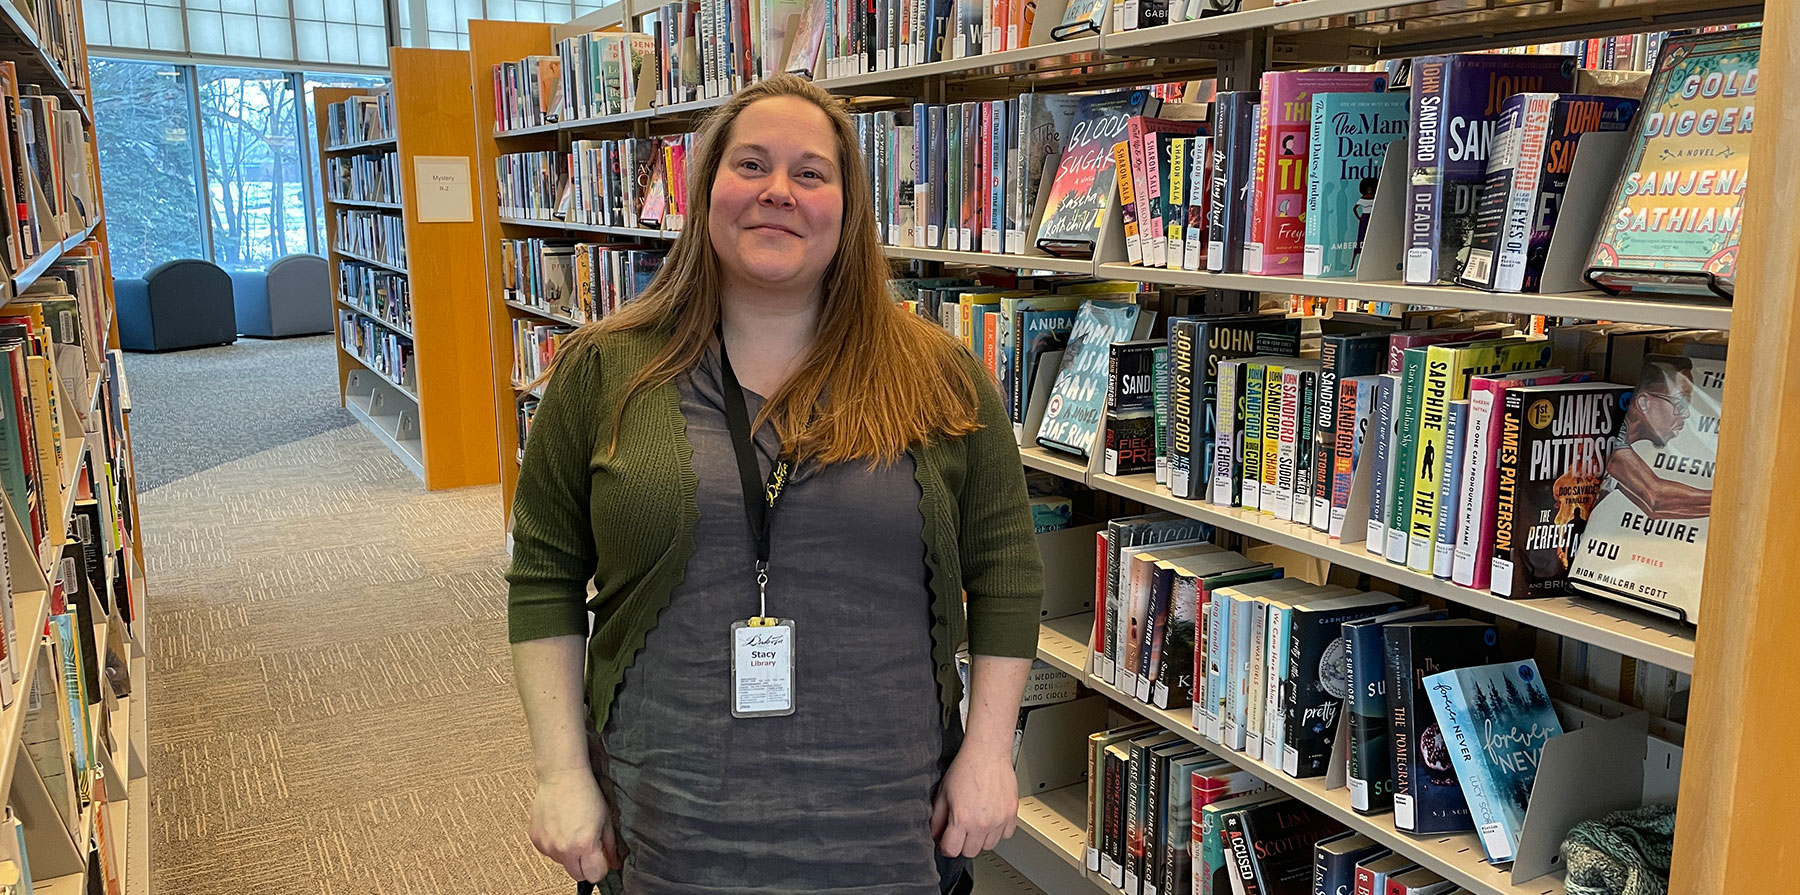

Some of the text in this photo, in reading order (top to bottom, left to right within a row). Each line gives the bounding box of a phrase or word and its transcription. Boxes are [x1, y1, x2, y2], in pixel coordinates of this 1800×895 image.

[1681, 68, 1759, 100] GOLD
[1331, 112, 1359, 136] The
[1417, 62, 1443, 161] JOHN SANDFORD
[1563, 100, 1604, 137] JOHN
[1643, 105, 1754, 137] DIGGER
[1031, 122, 1060, 142] The
[1068, 113, 1131, 152] BLOOD
[1255, 99, 1269, 182] LOST TICKET
[1055, 143, 1117, 182] SUGAR
[1146, 140, 1158, 195] SHARON SALA
[1309, 99, 1324, 212] The Many Dates Indigo
[1686, 149, 1715, 157] NOVEL
[1117, 148, 1131, 202] SHARON SALA
[1193, 143, 1203, 201] SHARON SALA
[1211, 150, 1228, 200] And They
[1509, 98, 1550, 242] JOHN SANDFORD EYES
[1060, 187, 1099, 210] Sascha
[1043, 208, 1099, 238] Rothchild
[1615, 207, 1743, 233] SATHIAN
[1331, 242, 1358, 251] AMBER
[1070, 319, 1129, 348] WOMAN
[1209, 327, 1254, 353] JOHN
[1077, 350, 1096, 372] IS
[1408, 364, 1418, 386] Stars
[1052, 371, 1098, 402] MAN
[1107, 373, 1115, 407] SANDFORD
[1175, 329, 1192, 453] JOHN SANDFORD
[1406, 394, 1412, 405] an
[1424, 361, 1448, 431] SAPPHIRE
[1062, 403, 1099, 424] A NOVEL
[1246, 381, 1262, 439] SANDFORD
[1266, 382, 1282, 440] SANDFORD
[1280, 384, 1297, 444] SANDFORD
[1302, 406, 1312, 440] SANDFORD
[1317, 342, 1338, 483] JOHN SANDFORD STORM
[1380, 400, 1390, 426] light
[1404, 406, 1415, 432] Italian
[1532, 403, 1548, 422] 1st
[1552, 393, 1614, 437] JAMES
[1038, 417, 1097, 451] ETAF RUM
[1336, 396, 1356, 460] SANDFORD
[1380, 426, 1387, 440] we
[1400, 433, 1412, 448] Sky
[1475, 420, 1481, 431] NO
[1501, 412, 1520, 465] JAMES
[1378, 440, 1387, 460] lost
[1442, 411, 1457, 496] THE MEMORY MONSTER
[1297, 468, 1307, 494] WICKED
[1465, 468, 1476, 512] PRONOUNCE
[1558, 484, 1600, 497] DOC SAVAGE
[1415, 490, 1435, 518] THE
[1464, 514, 1472, 524] MY
[1496, 466, 1516, 551] PATTERSON
[1539, 509, 1552, 523] THE
[1526, 523, 1574, 551] PERFECT
[1621, 512, 1699, 543] REQUIRE
[1587, 539, 1620, 561] YOU
[1631, 554, 1664, 568] STORIES
[1576, 567, 1668, 599] RION AMILCAR SCOTT
[1145, 616, 1155, 646] FOREVER
[1273, 612, 1279, 625] We
[1318, 614, 1351, 625] CARMEN
[1211, 620, 1220, 655] friendly
[751, 651, 776, 659] Stacy
[1425, 658, 1440, 672] The
[1046, 691, 1067, 700] CIRCLE
[1269, 683, 1277, 704] Shine
[1347, 656, 1355, 705] SURVIVORS
[1302, 701, 1338, 728] pretty
[1394, 707, 1406, 727] THE
[1432, 681, 1483, 799] forever NEVER LUCY
[1483, 718, 1555, 766] forever
[1127, 749, 1139, 841] IN CASE OF EMERGENCY
[1149, 797, 1155, 808] OF
[1276, 811, 1311, 830] LISA
[1166, 830, 1175, 867] KIERAN
[1228, 830, 1254, 880] ACCUSED
